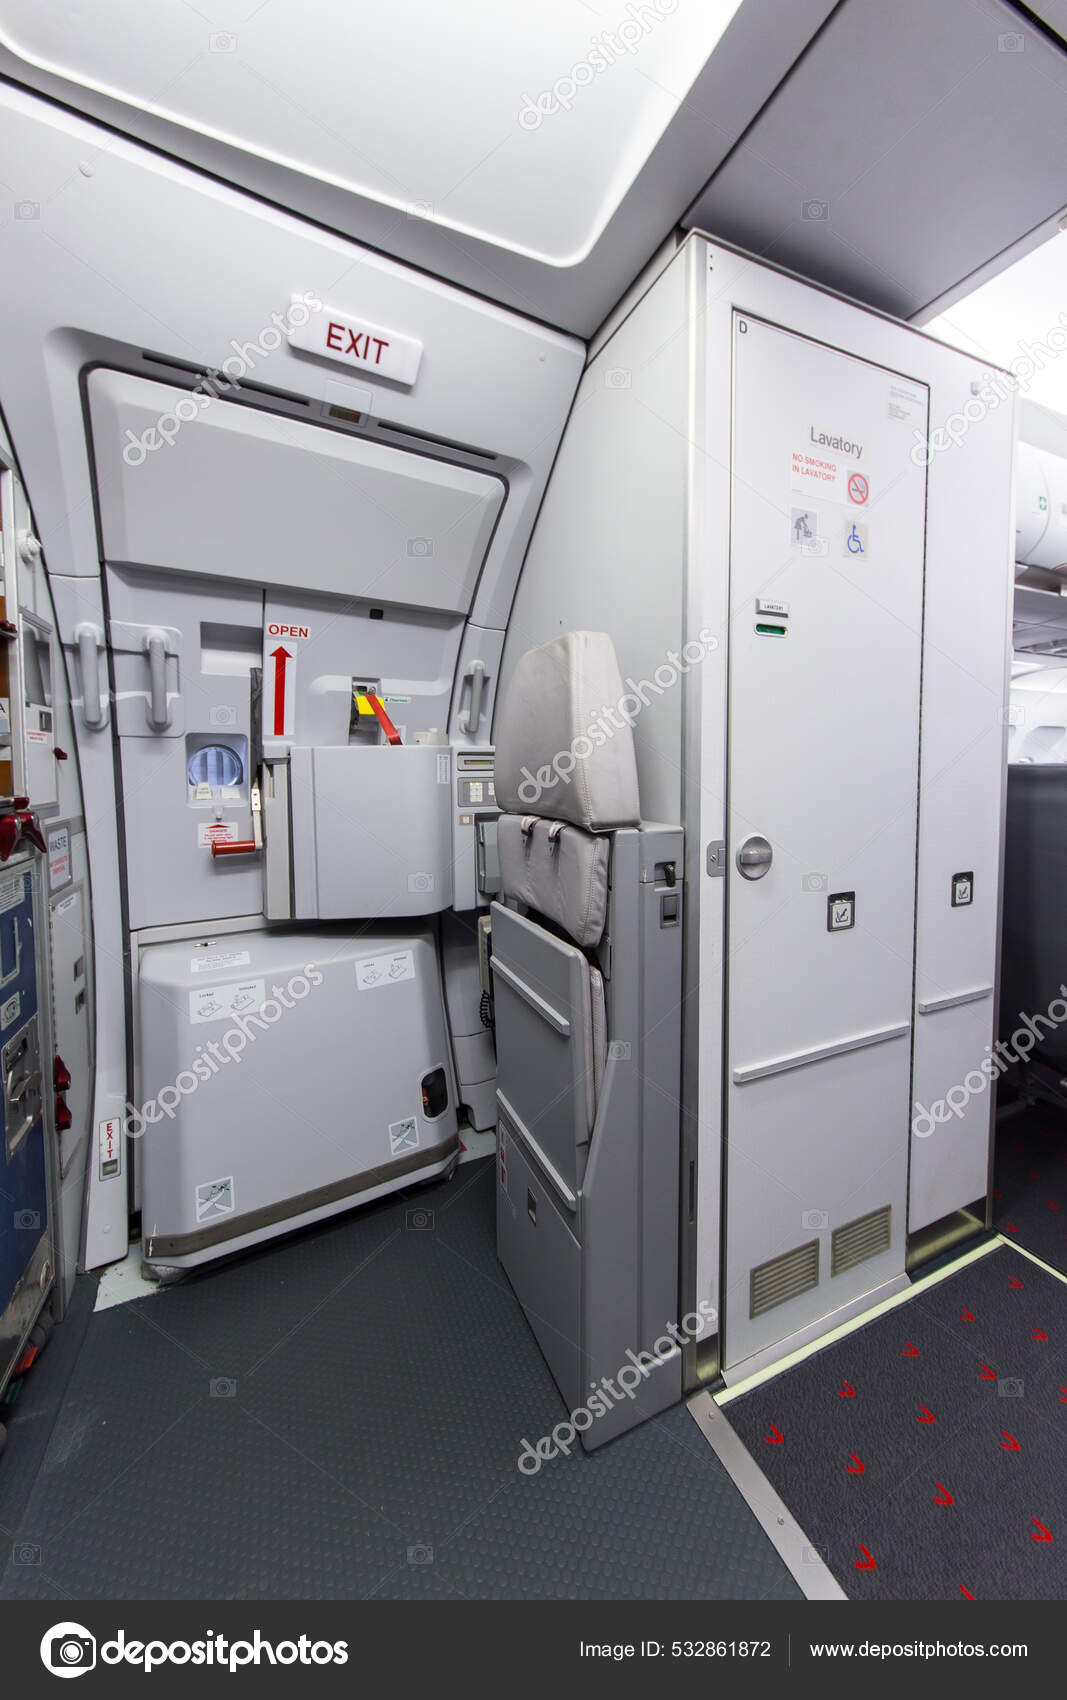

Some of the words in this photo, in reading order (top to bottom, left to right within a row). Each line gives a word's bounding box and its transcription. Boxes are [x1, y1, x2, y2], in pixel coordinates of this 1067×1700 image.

[739, 320, 748, 334] D
[326, 322, 389, 364] EXIT
[810, 426, 863, 459] Lavatory
[792, 453, 803, 463] NO
[805, 456, 837, 473] SMOKING
[792, 464, 800, 473] IN
[801, 466, 835, 482] LAVATORY
[268, 624, 309, 638] OPEN
